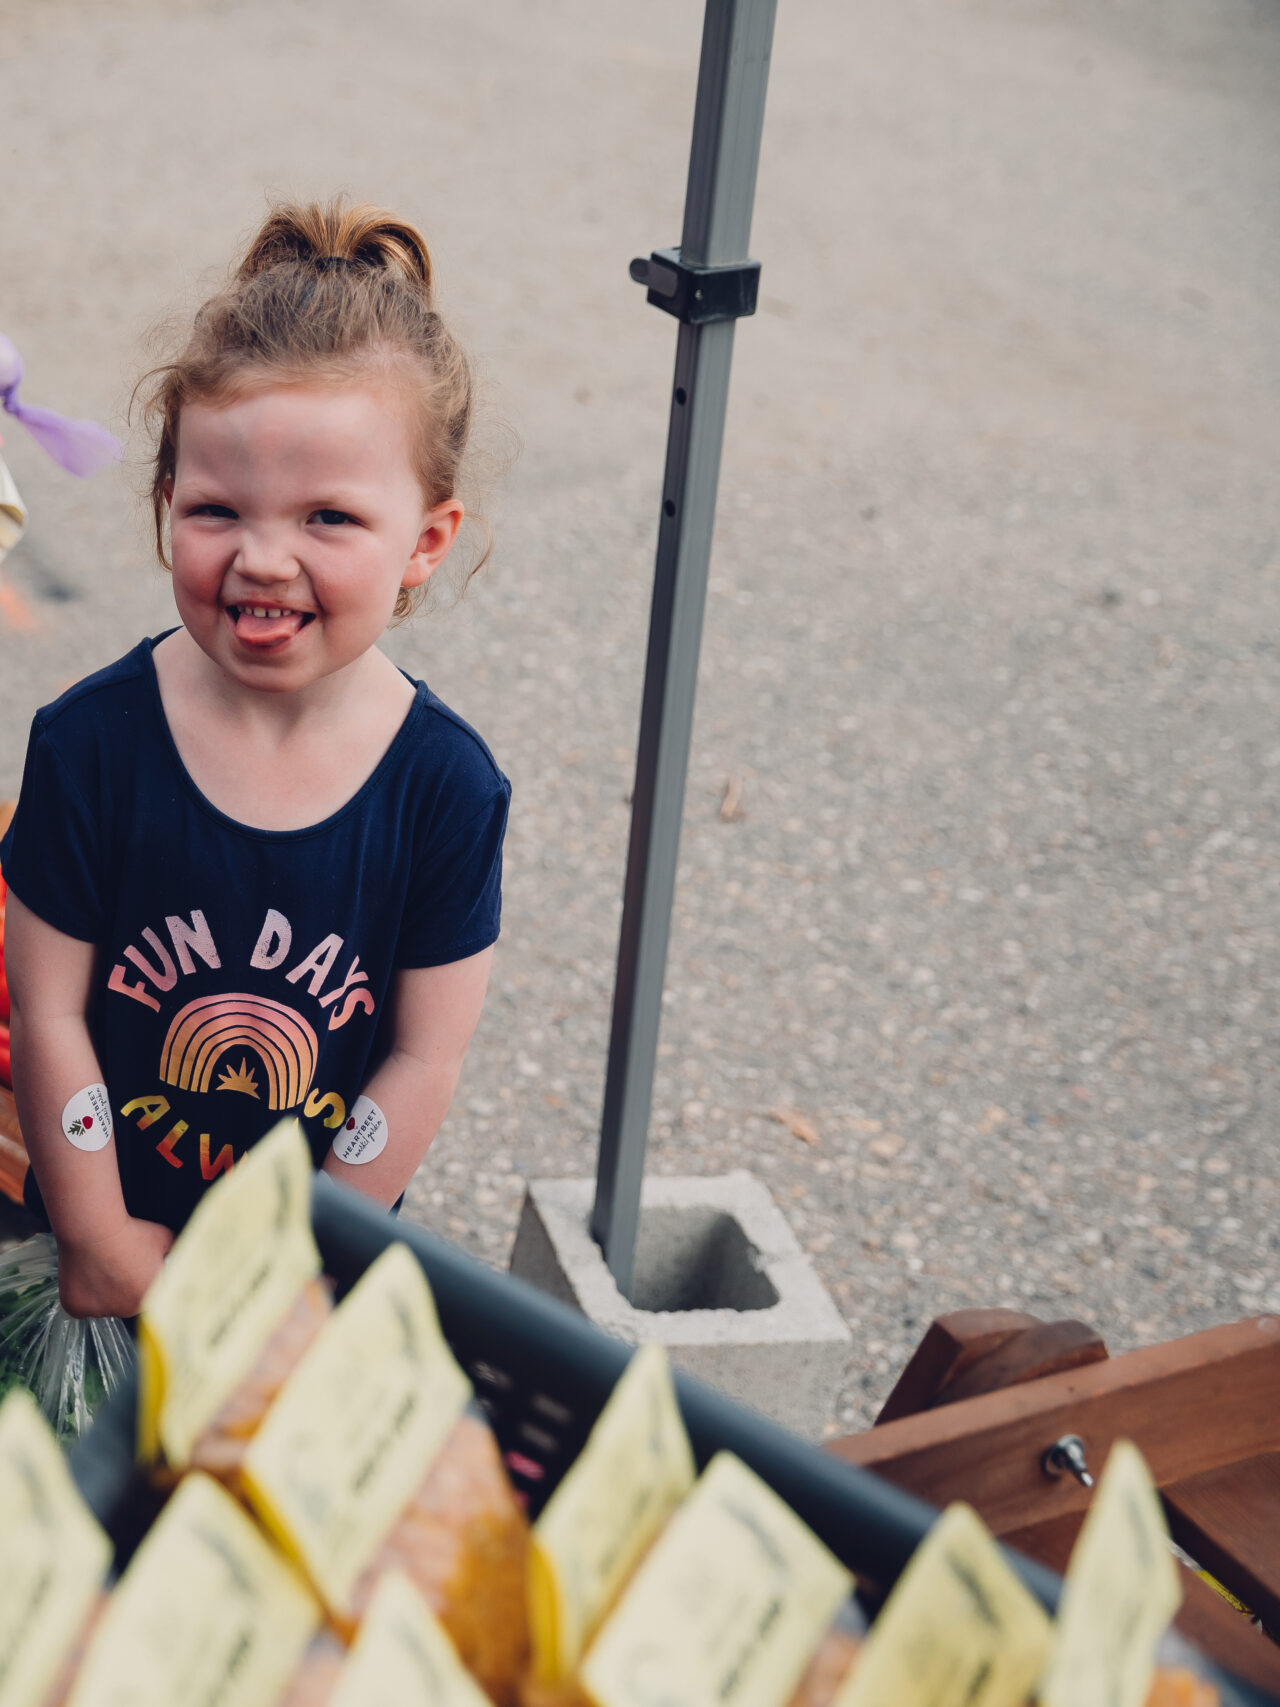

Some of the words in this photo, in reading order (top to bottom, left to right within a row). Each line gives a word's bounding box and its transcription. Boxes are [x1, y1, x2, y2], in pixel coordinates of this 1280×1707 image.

[107, 909, 222, 1014] FUN
[249, 908, 375, 1031] DAYS
[88, 1090, 109, 1138] HEARTBEET
[120, 1087, 346, 1181] ALWS
[342, 1109, 377, 1158] HEARTBEET
[354, 1135, 370, 1158] market
[367, 1119, 382, 1142] garden
